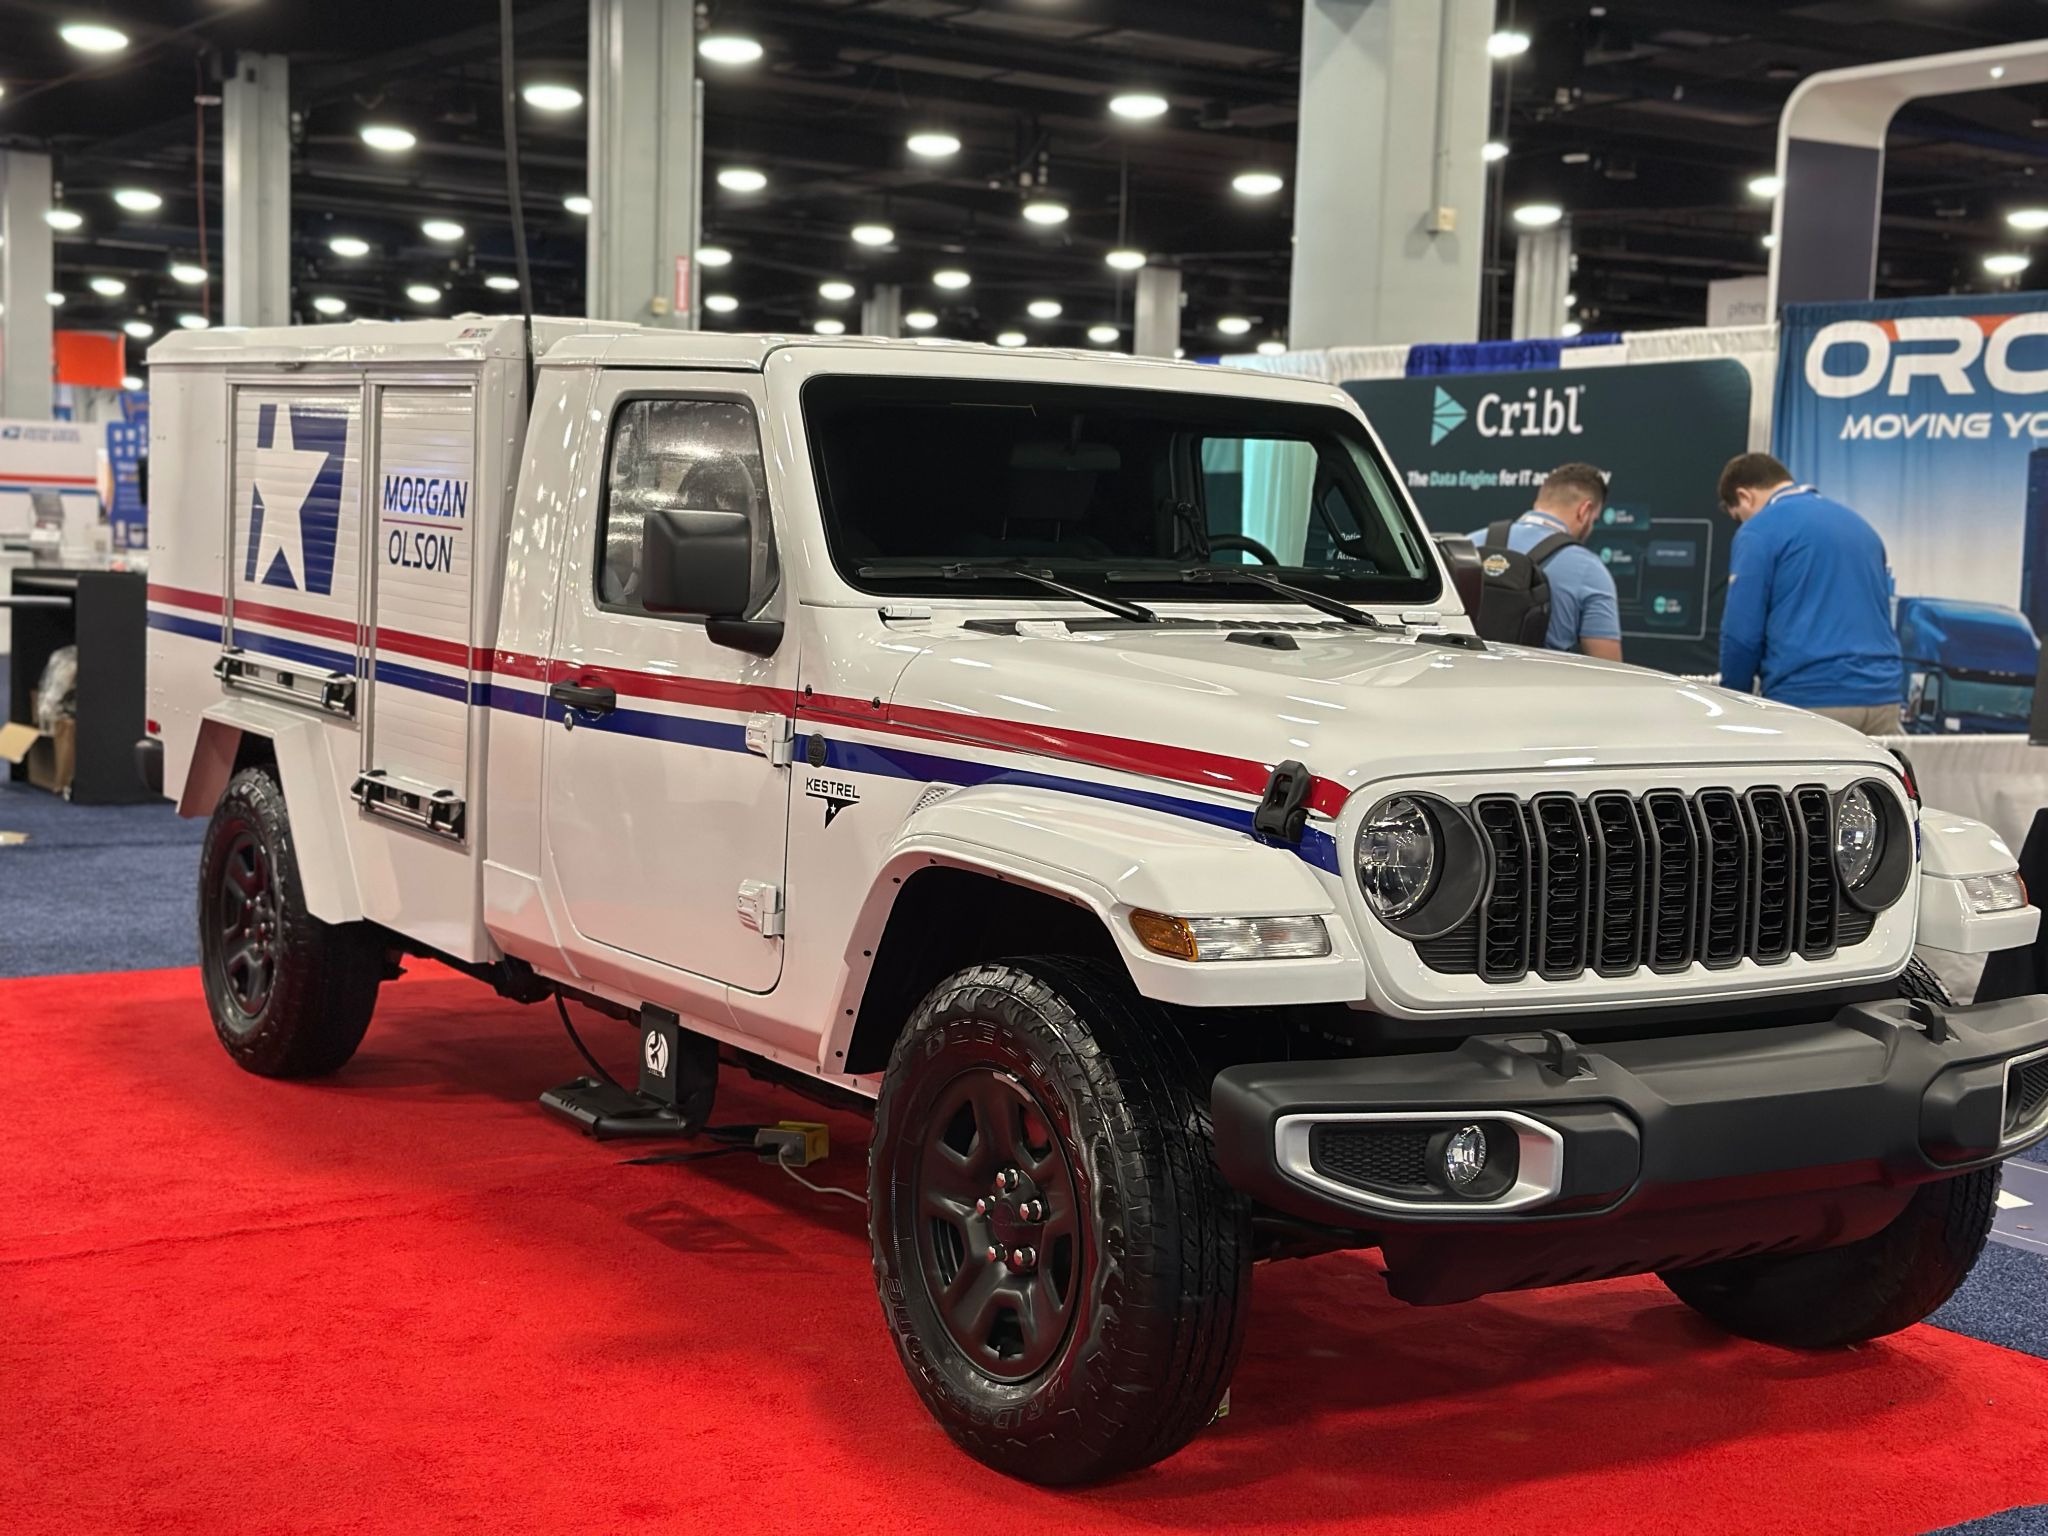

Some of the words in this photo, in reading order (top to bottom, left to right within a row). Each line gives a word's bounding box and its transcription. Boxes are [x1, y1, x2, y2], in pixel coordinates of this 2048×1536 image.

[1476, 386, 1583, 437] Cribl
[1840, 412, 1992, 440] MOVING
[383, 475, 468, 518] MORGAN
[1407, 470, 1429, 487] The
[1430, 471, 1457, 487] Data
[1459, 470, 1498, 490] Engine
[1500, 469, 1518, 486] for
[1519, 469, 1532, 486] IT
[388, 529, 453, 573] OLSON
[806, 777, 861, 799] KESTREL
